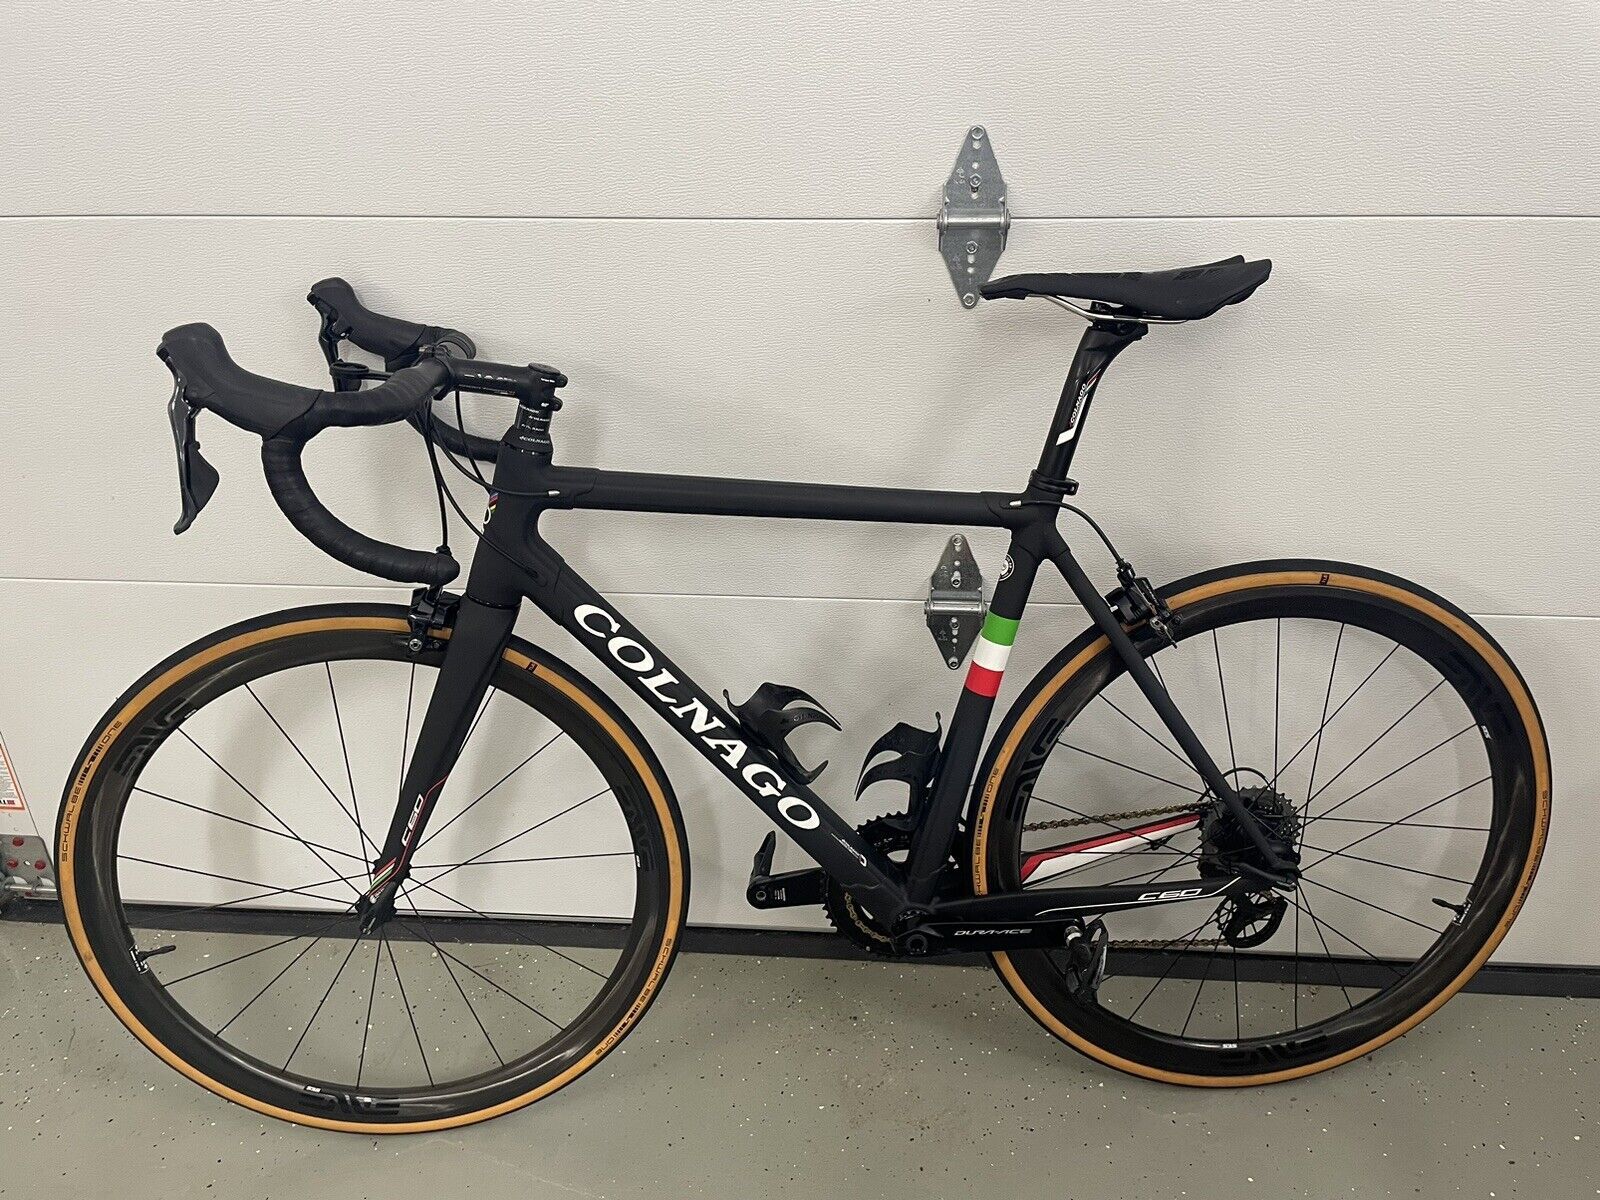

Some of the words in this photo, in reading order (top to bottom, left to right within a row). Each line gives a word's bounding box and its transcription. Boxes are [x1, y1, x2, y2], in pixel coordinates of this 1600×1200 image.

[1070, 383, 1087, 423] COLNAGO
[573, 604, 820, 830] COLNAGO
[62, 787, 82, 862] SCHWALBE
[101, 720, 122, 744] ONE
[987, 767, 999, 793] ONE
[640, 938, 673, 1003] SCHWALBE
[595, 1037, 616, 1056] ONE
